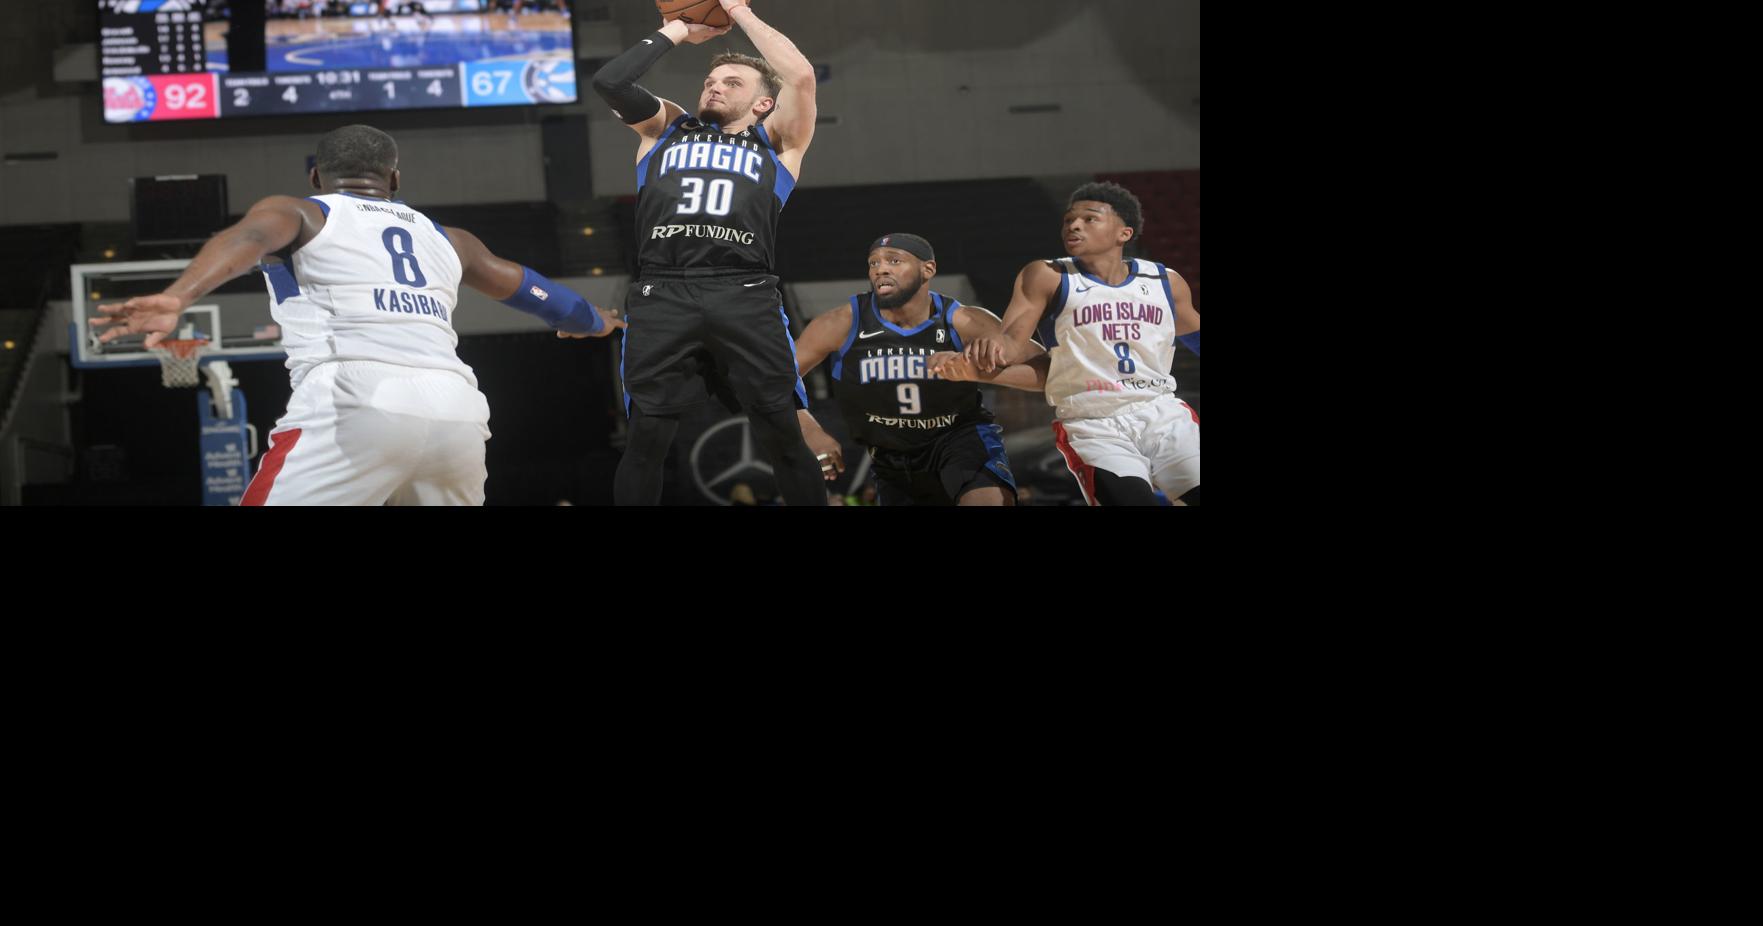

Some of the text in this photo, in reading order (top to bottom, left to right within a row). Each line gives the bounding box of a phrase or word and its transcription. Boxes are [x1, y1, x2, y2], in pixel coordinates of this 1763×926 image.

[282, 85, 298, 104] 4
[384, 81, 396, 99] 1
[426, 78, 443, 97] 4
[472, 70, 512, 96] 67
[164, 83, 207, 110] 92
[233, 87, 250, 107] 2
[659, 142, 763, 184] MAGIC
[676, 177, 734, 217] 30
[651, 224, 755, 245] RP FUNDING
[381, 226, 428, 288] 8
[373, 288, 448, 322] KASIBA
[1073, 302, 1164, 328] LONG ISLAND
[1102, 323, 1142, 341] NETS
[867, 347, 936, 358] LAKELAN
[1113, 342, 1136, 375] 8
[860, 355, 945, 384] MAG
[896, 383, 922, 415] 9
